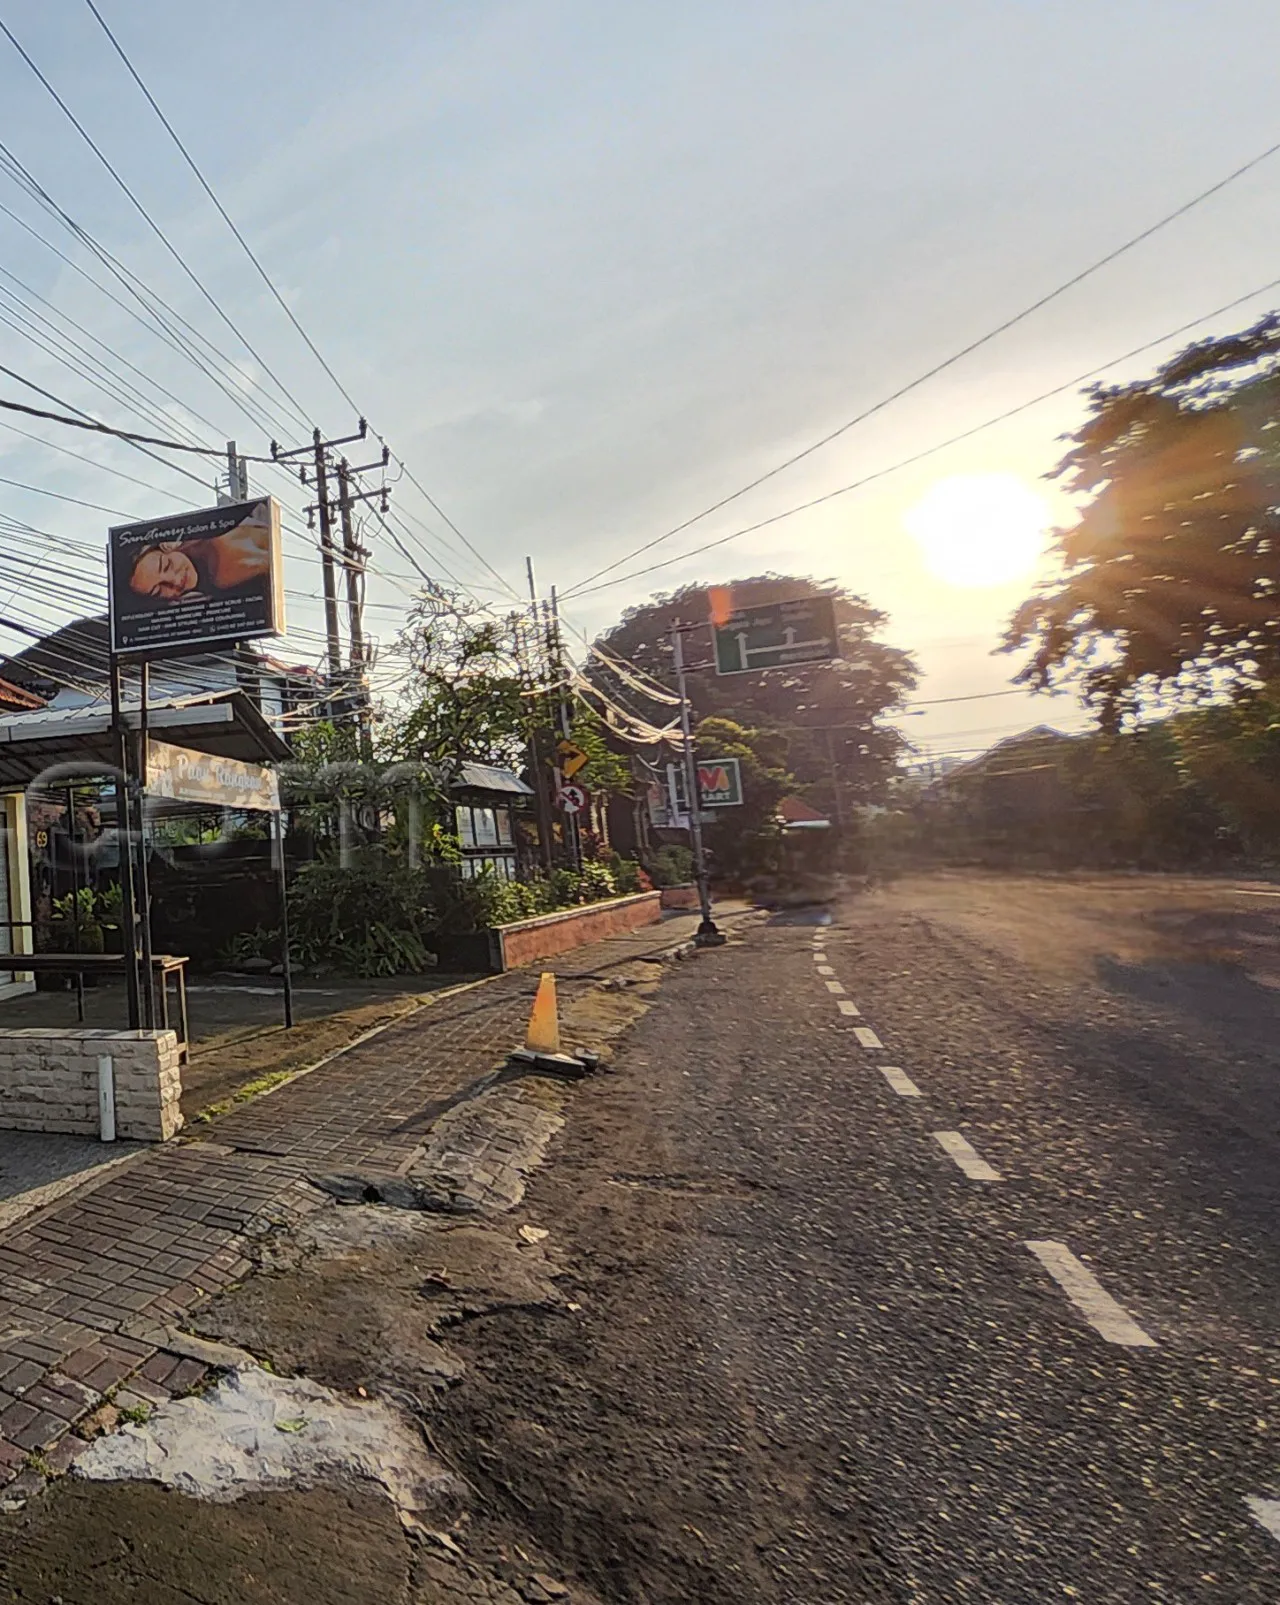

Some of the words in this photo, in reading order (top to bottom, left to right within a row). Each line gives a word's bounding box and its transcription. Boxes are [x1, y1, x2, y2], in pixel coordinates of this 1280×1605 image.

[187, 523, 208, 535] Salon
[210, 521, 216, 530] &
[219, 519, 235, 530] Spa
[37, 831, 48, 848] 69
